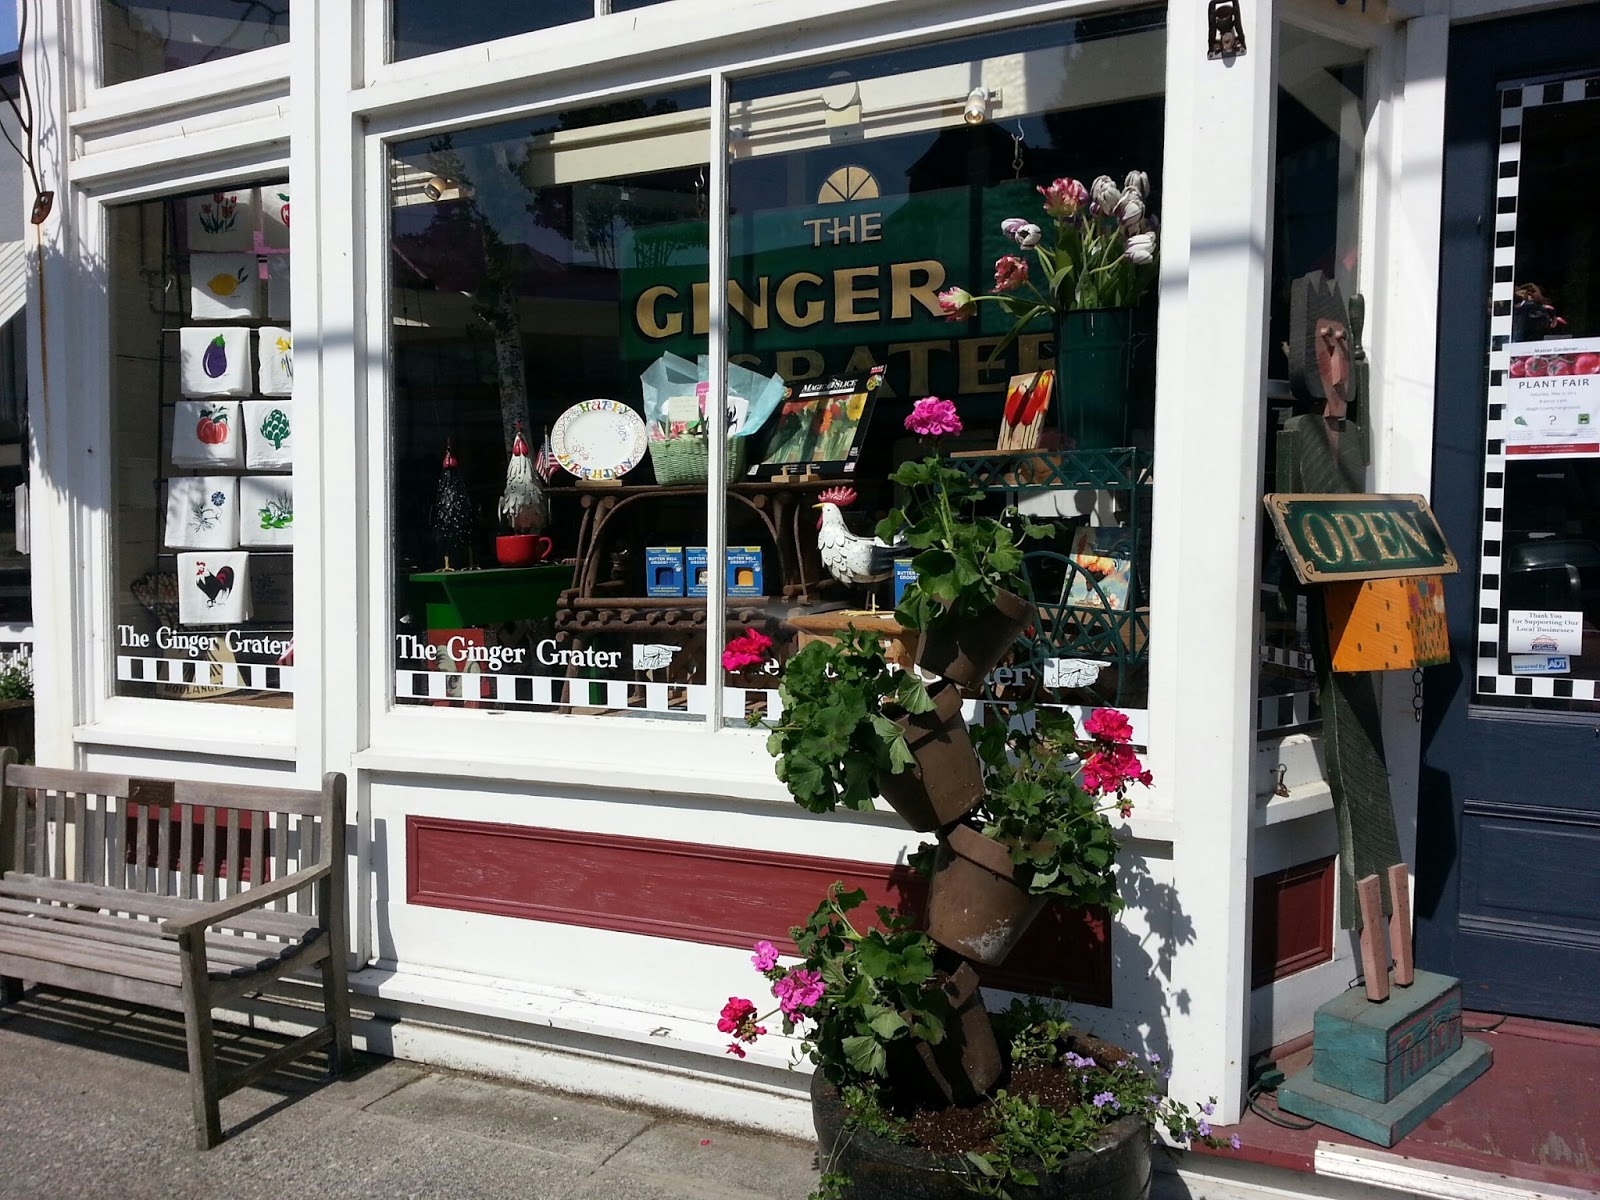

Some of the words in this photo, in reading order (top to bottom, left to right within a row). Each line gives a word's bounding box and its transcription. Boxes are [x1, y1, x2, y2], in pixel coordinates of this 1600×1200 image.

[804, 212, 882, 248] THE
[636, 259, 953, 338] GINGER
[1519, 380, 1557, 389] PLANT
[1562, 378, 1590, 387] FAIR
[1302, 512, 1434, 564] OPEN
[118, 625, 149, 647] The
[156, 626, 217, 657] Ginger
[225, 630, 291, 655] Grater
[396, 634, 436, 661] The
[446, 636, 526, 671] Ginger
[536, 639, 622, 668] Grater
[1549, 659, 1566, 668] ADT
[164, 682, 224, 695] BOULANGE
